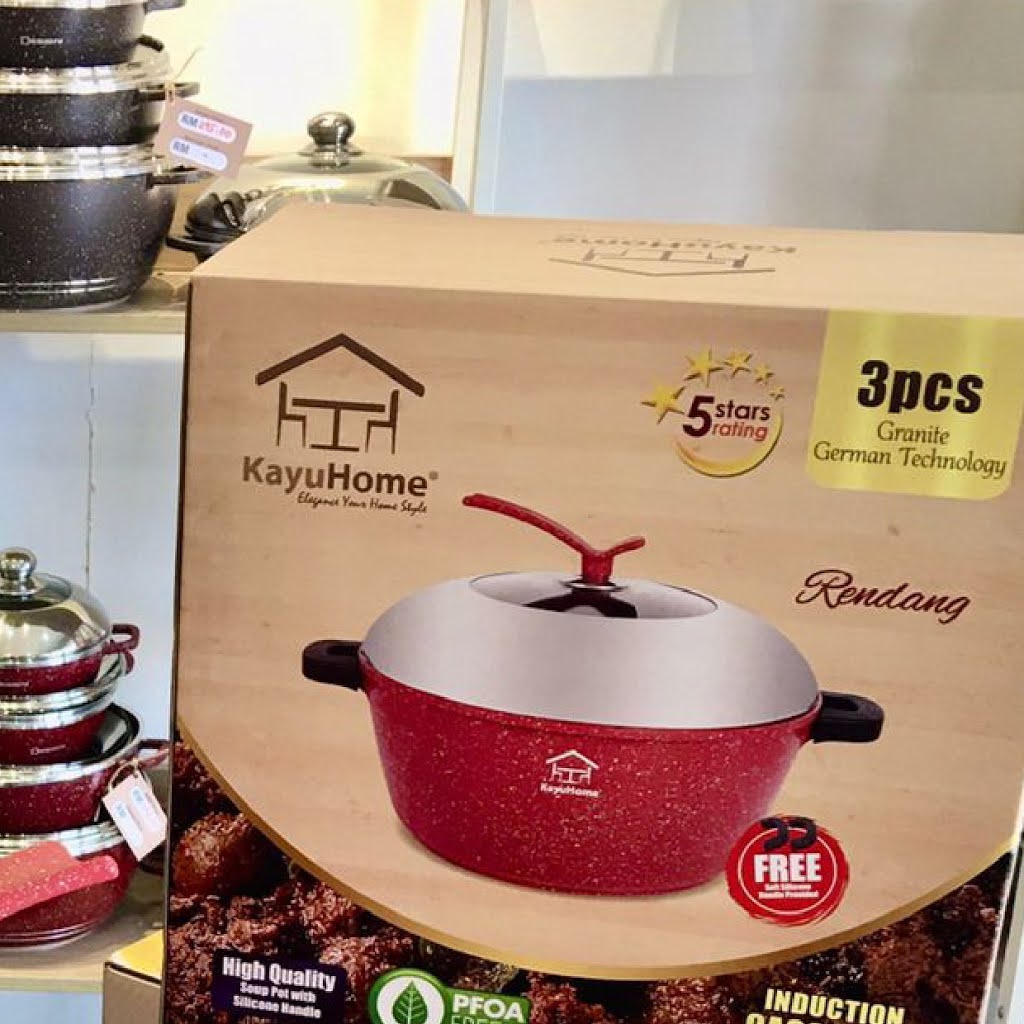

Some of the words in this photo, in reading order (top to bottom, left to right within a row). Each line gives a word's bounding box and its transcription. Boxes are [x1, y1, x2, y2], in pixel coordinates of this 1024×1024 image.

[857, 359, 985, 414] 3pcs
[682, 395, 715, 437] 5
[715, 400, 771, 421] stars
[712, 421, 768, 442] rating
[876, 421, 951, 446] Granite
[814, 441, 892, 466] German
[900, 446, 1008, 480] Technology
[795, 569, 971, 625] Rendang
[754, 852, 822, 883] FREE
[222, 956, 265, 981] High
[268, 962, 336, 992] Quality
[233, 995, 280, 1014] Silicone
[281, 1001, 322, 1019] Handle
[239, 981, 269, 997] Soup
[290, 988, 316, 1003] with
[452, 994, 524, 1023] PFOA
